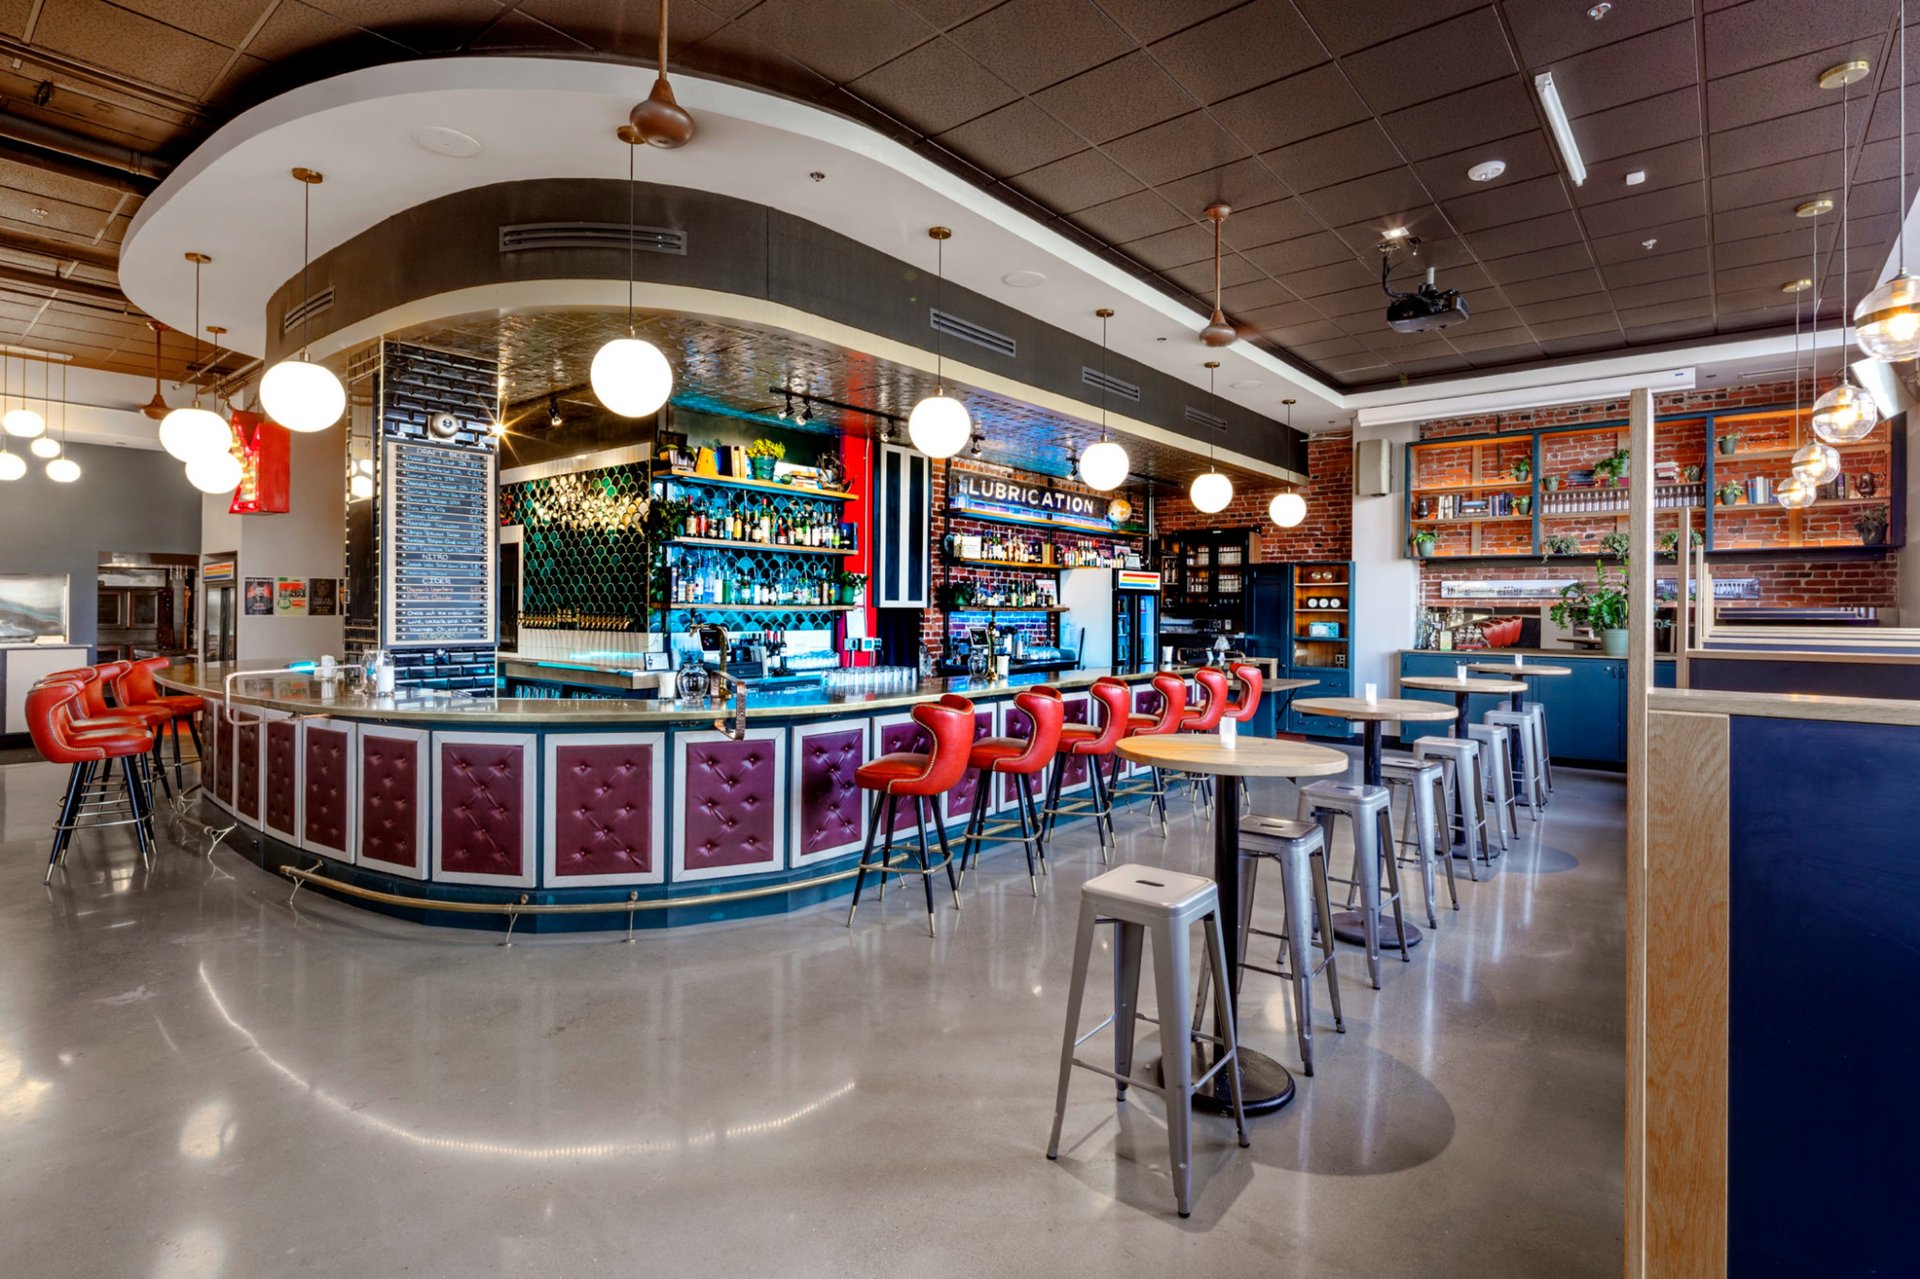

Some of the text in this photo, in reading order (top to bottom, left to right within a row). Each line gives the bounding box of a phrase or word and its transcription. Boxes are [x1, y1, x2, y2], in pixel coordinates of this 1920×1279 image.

[416, 448, 470, 460] DRAFT BEER
[968, 477, 1094, 514] LUBRICATION
